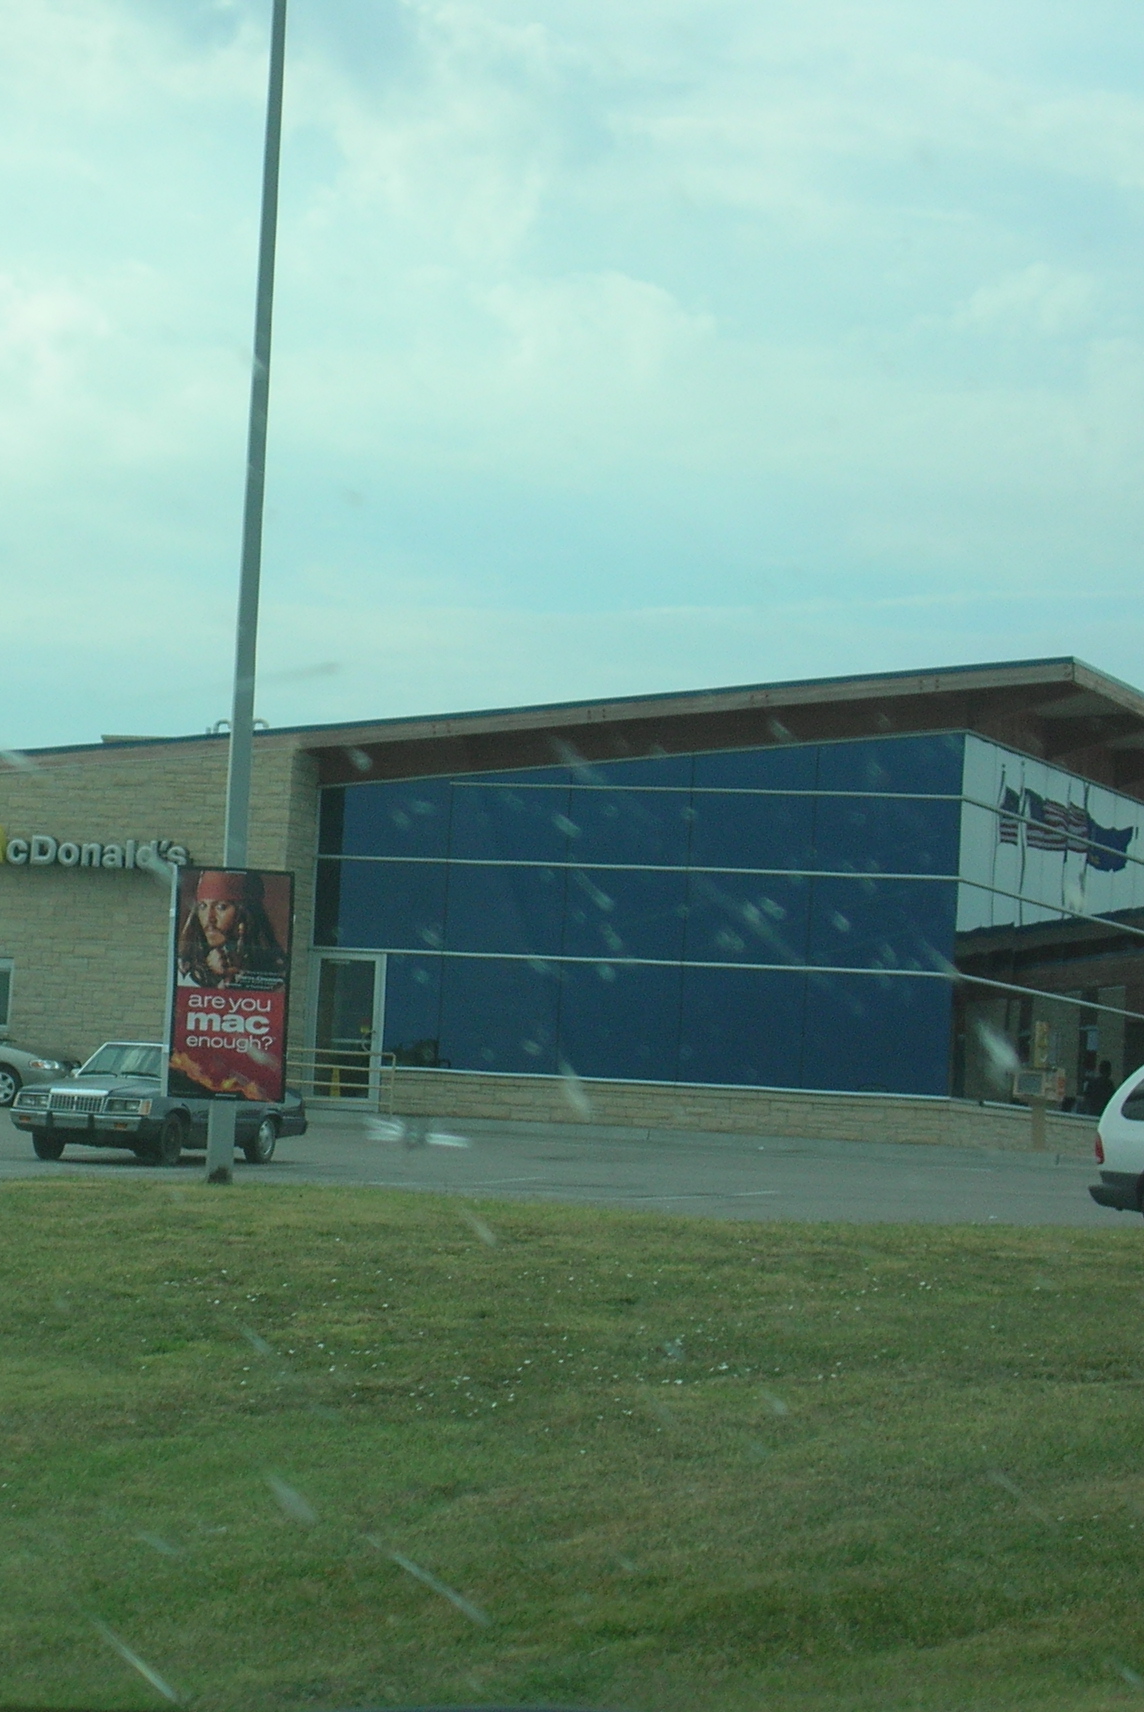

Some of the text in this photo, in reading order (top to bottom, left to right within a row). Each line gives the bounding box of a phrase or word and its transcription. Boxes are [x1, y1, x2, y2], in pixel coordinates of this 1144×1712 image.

[188, 993, 272, 1013] are you
[186, 1011, 271, 1035] mac
[185, 1035, 274, 1053] enough?
